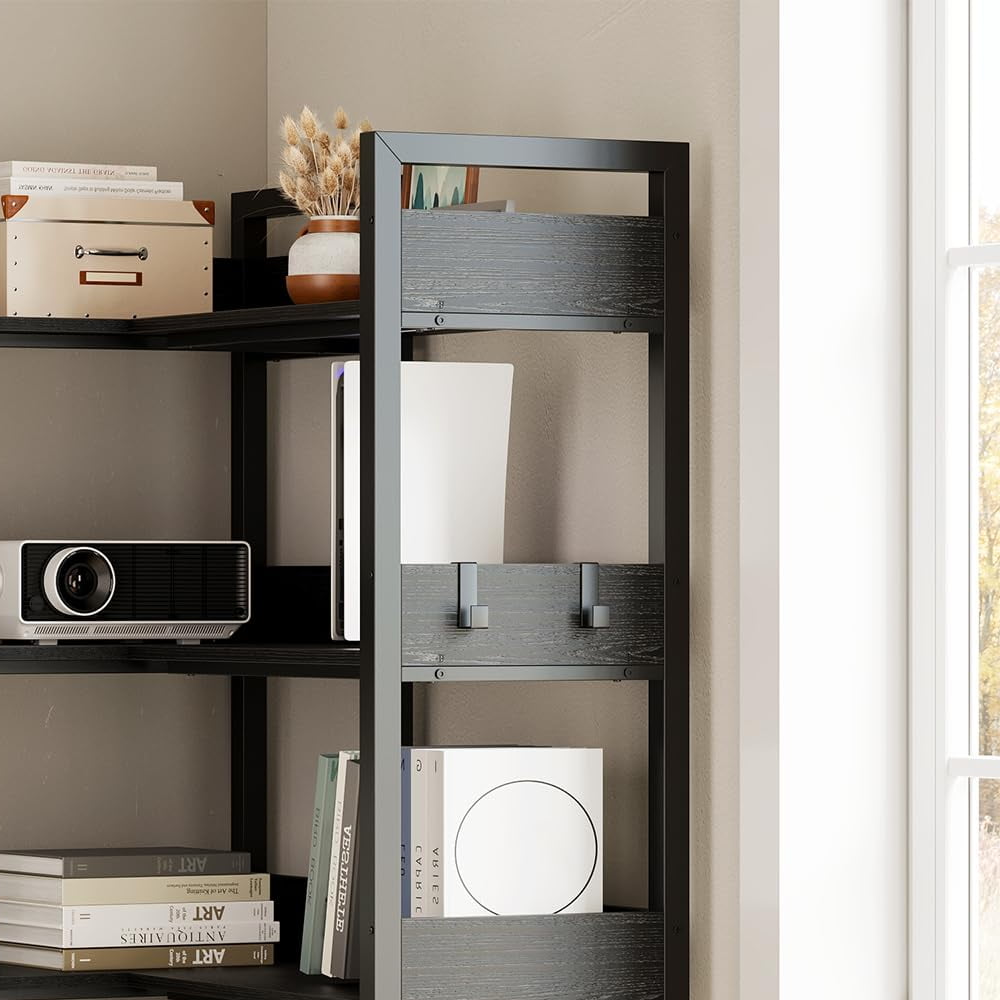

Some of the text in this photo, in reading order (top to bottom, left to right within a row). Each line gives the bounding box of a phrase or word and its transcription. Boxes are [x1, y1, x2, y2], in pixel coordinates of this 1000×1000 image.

[178, 857, 207, 872] ART
[186, 887, 209, 896] Knitting
[193, 906, 225, 921] ART
[120, 929, 226, 944] ANTIQUAIRES
[193, 948, 225, 964] ART
